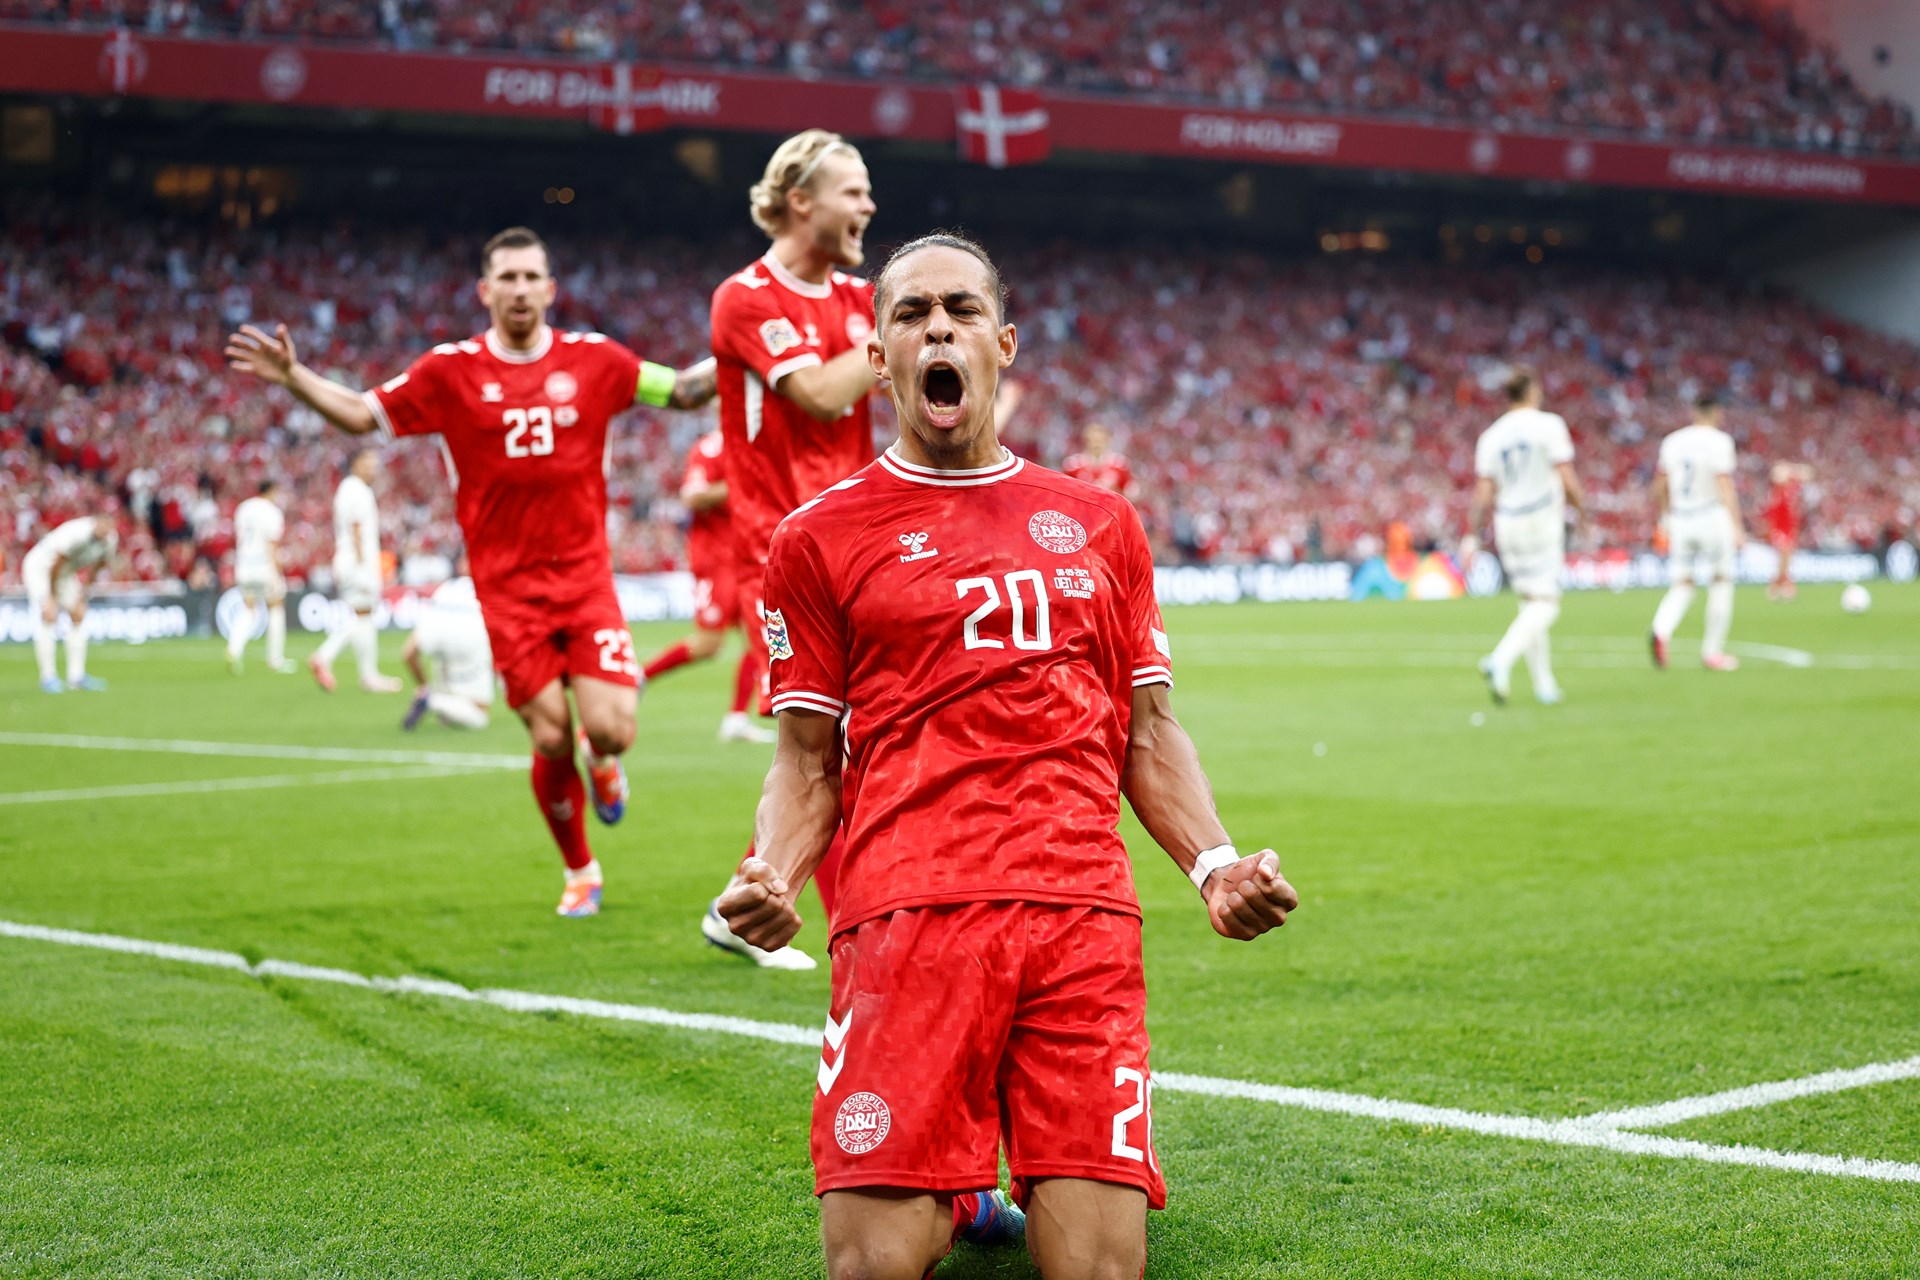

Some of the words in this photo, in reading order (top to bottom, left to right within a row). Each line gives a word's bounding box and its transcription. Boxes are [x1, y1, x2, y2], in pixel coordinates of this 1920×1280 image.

[484, 68, 556, 104] FOR
[502, 406, 555, 459] 23
[1040, 525, 1075, 538] DBU
[900, 547, 939, 564] hummel
[955, 568, 1053, 651] 20
[845, 1112, 877, 1132] DBU
[874, 1109, 888, 1143] UNION
[850, 1142, 872, 1152] 1889
